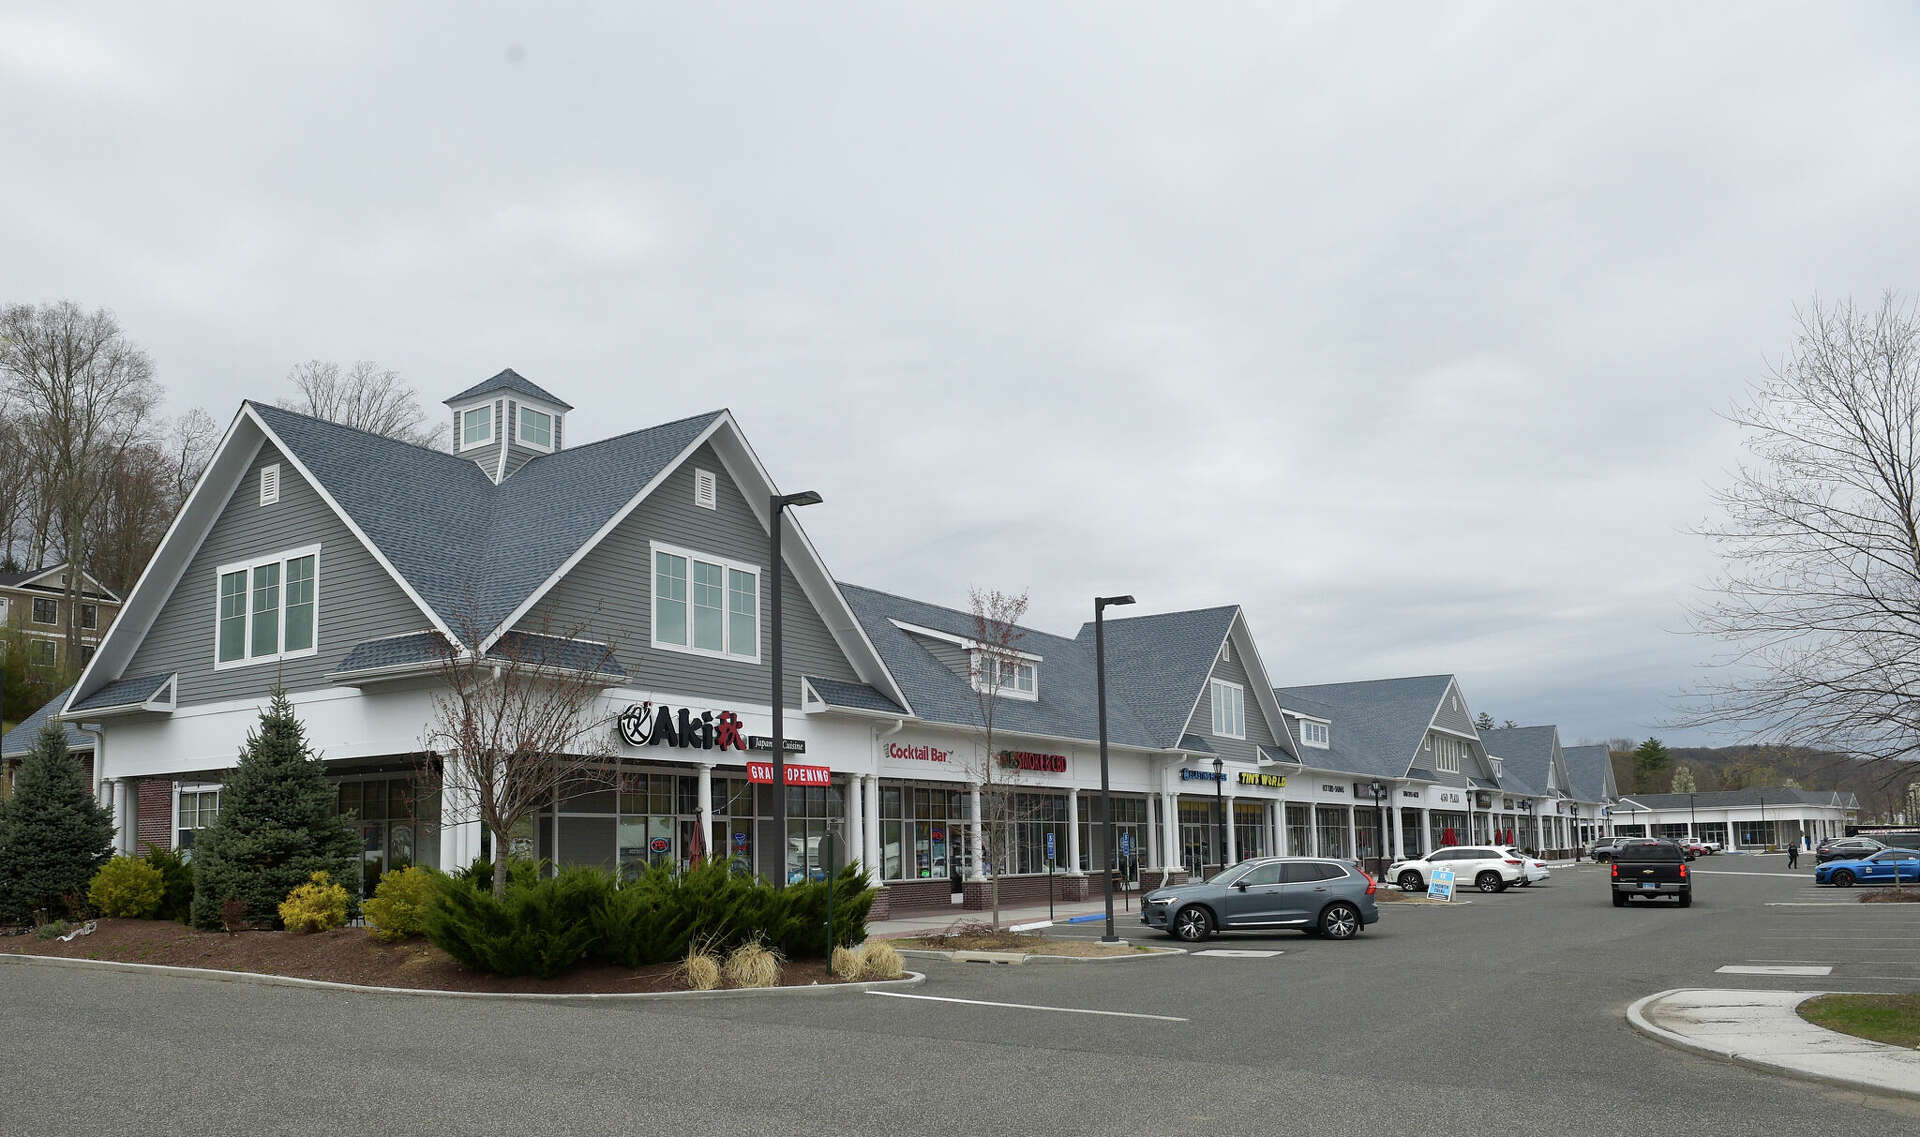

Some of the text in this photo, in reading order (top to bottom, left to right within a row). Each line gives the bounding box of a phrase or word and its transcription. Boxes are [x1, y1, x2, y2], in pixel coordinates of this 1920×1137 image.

[649, 706, 714, 750] Aki
[782, 740, 804, 751] Cuisine
[890, 743, 929, 761] Cocktail
[931, 748, 947, 763] Bar
[1018, 752, 1045, 771] SMOKE
[751, 765, 829, 782] GRA OPENING
[1241, 772, 1260, 785] TINT
[1261, 774, 1287, 787] WORLD
